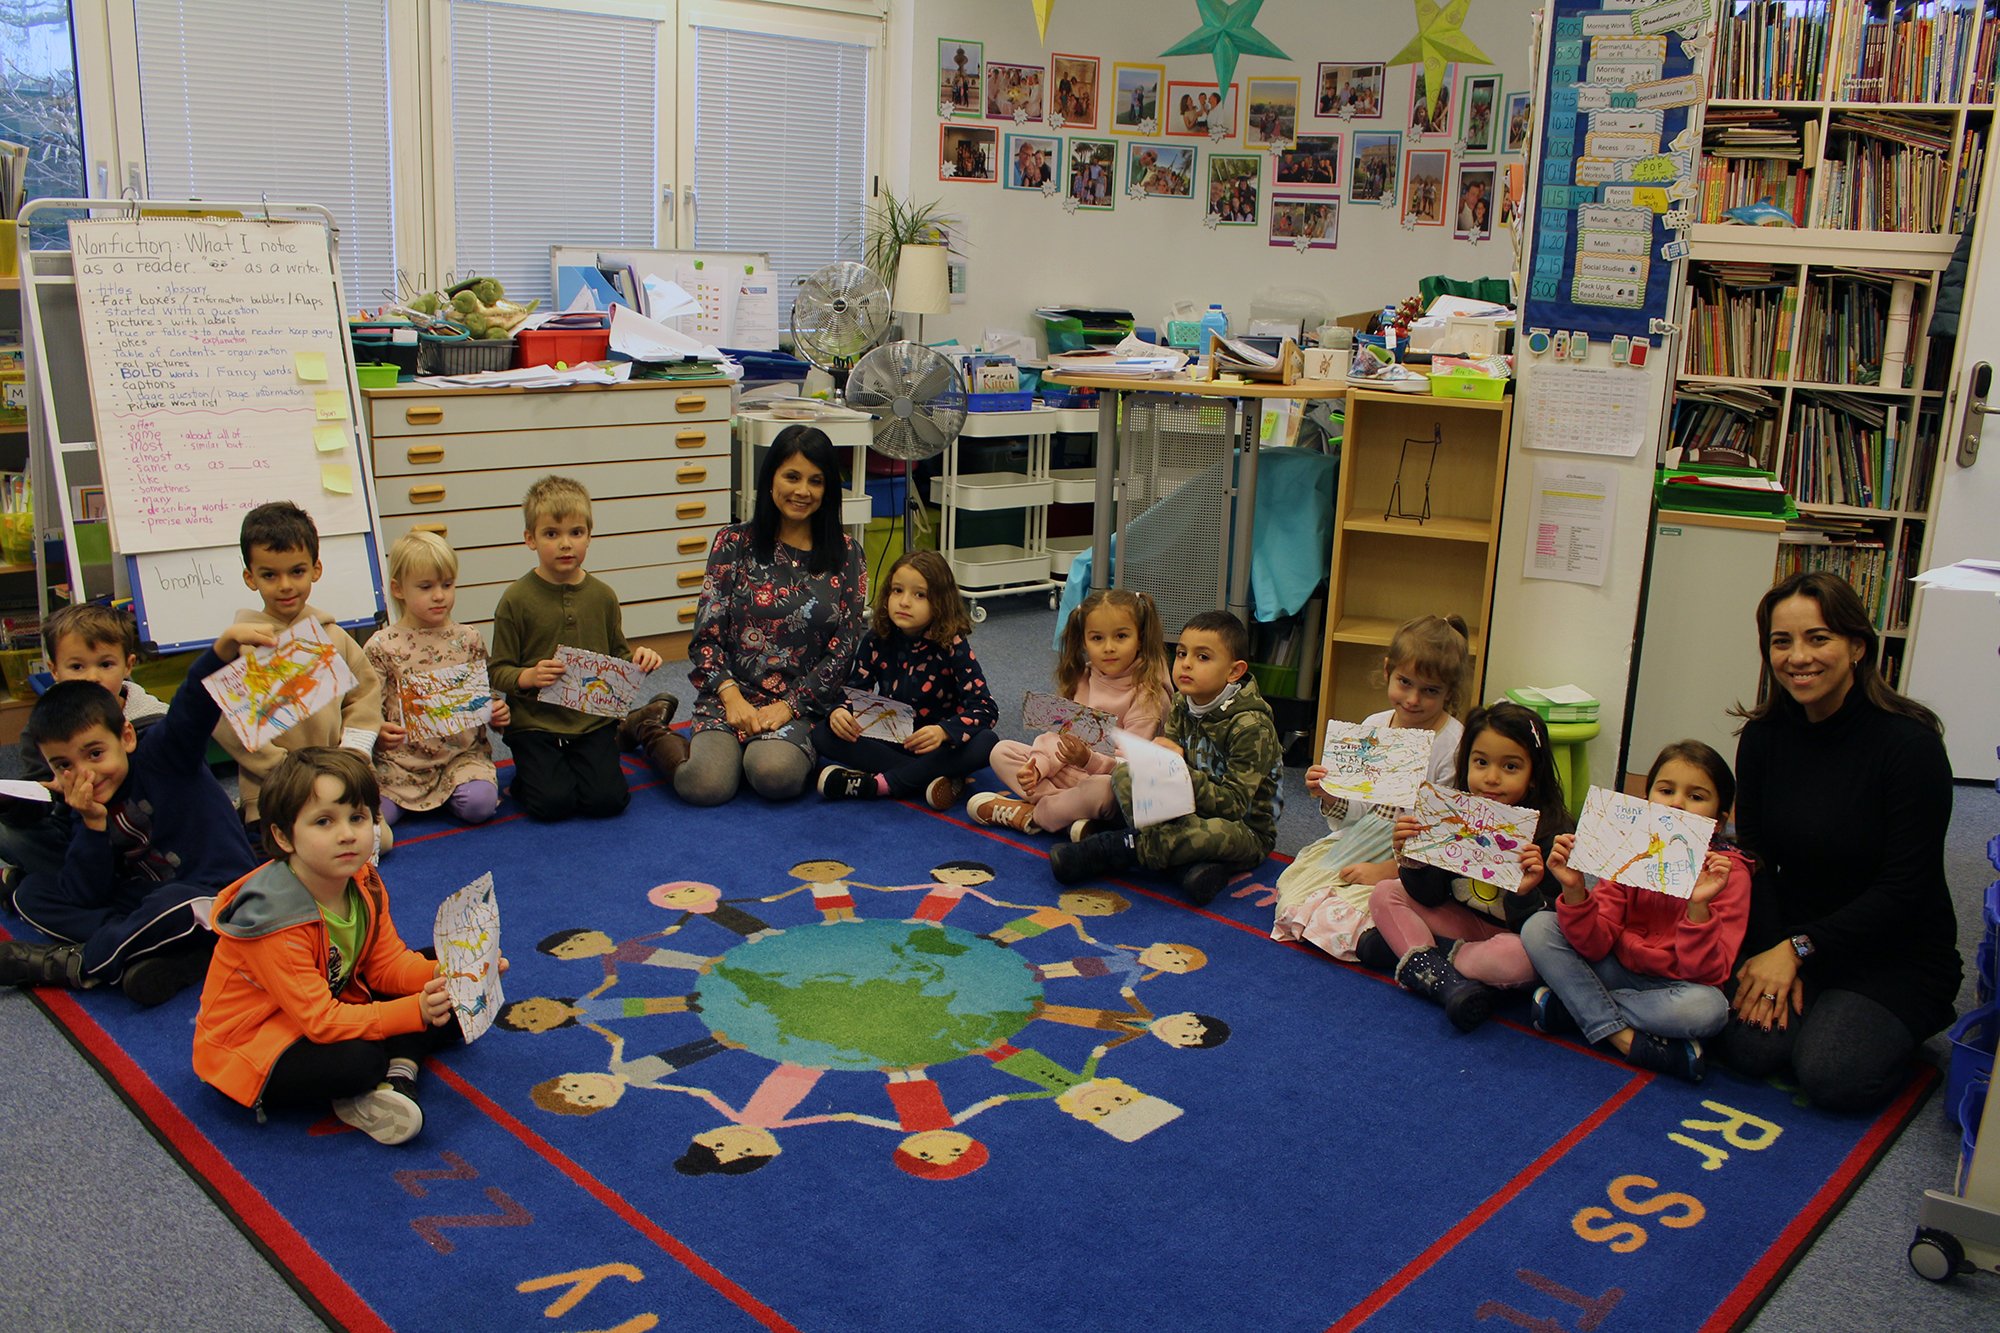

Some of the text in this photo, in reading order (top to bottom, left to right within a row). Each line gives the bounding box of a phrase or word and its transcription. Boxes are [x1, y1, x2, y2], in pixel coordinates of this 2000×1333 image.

[1642, 10, 1681, 26] Handwriting
[1586, 23, 1610, 31] Morning
[1596, 66, 1625, 75] Morning
[1659, 89, 1683, 99] Activity
[184, 231, 233, 253] What
[240, 233, 251, 254] I
[260, 236, 298, 253] notice
[1594, 240, 1611, 248] Math
[82, 264, 104, 274] as
[112, 262, 123, 274] a
[244, 263, 262, 274] as
[269, 263, 280, 274] a
[1583, 262, 1625, 273] Social Studies
[95, 281, 207, 297] titles glossary
[1596, 283, 1605, 292] Up
[139, 294, 176, 306] boxes
[250, 295, 285, 305] bubbles
[1596, 292, 1614, 300] Aloud
[105, 306, 260, 320] started with a question
[107, 317, 237, 332] pictures with labels
[146, 330, 157, 338] or
[162, 327, 188, 338] false
[202, 327, 212, 337] to
[251, 326, 283, 337] reader
[116, 338, 148, 351] jokes
[202, 336, 248, 345] explanation
[112, 346, 144, 358] Table
[149, 346, 160, 358] of
[169, 345, 217, 358] Contents
[115, 359, 190, 373] real pictures
[120, 368, 162, 379] BOLD
[169, 370, 199, 379] words
[217, 367, 257, 381] Fancy
[264, 365, 292, 375] words
[122, 381, 176, 395] captions
[983, 379, 1016, 390] Kitten
[12, 389, 24, 398] M
[202, 399, 218, 408] list
[185, 429, 213, 440] about
[217, 428, 229, 439] all
[1244, 415, 1253, 453] KETTLER
[190, 441, 219, 450] similar
[132, 451, 173, 464] almost
[136, 459, 271, 473] same as as as
[137, 473, 160, 484] like
[139, 485, 191, 494] sometimes
[142, 496, 171, 505] many
[202, 498, 229, 512] words
[185, 515, 213, 525] words
[1646, 871, 1680, 886] ROSE
